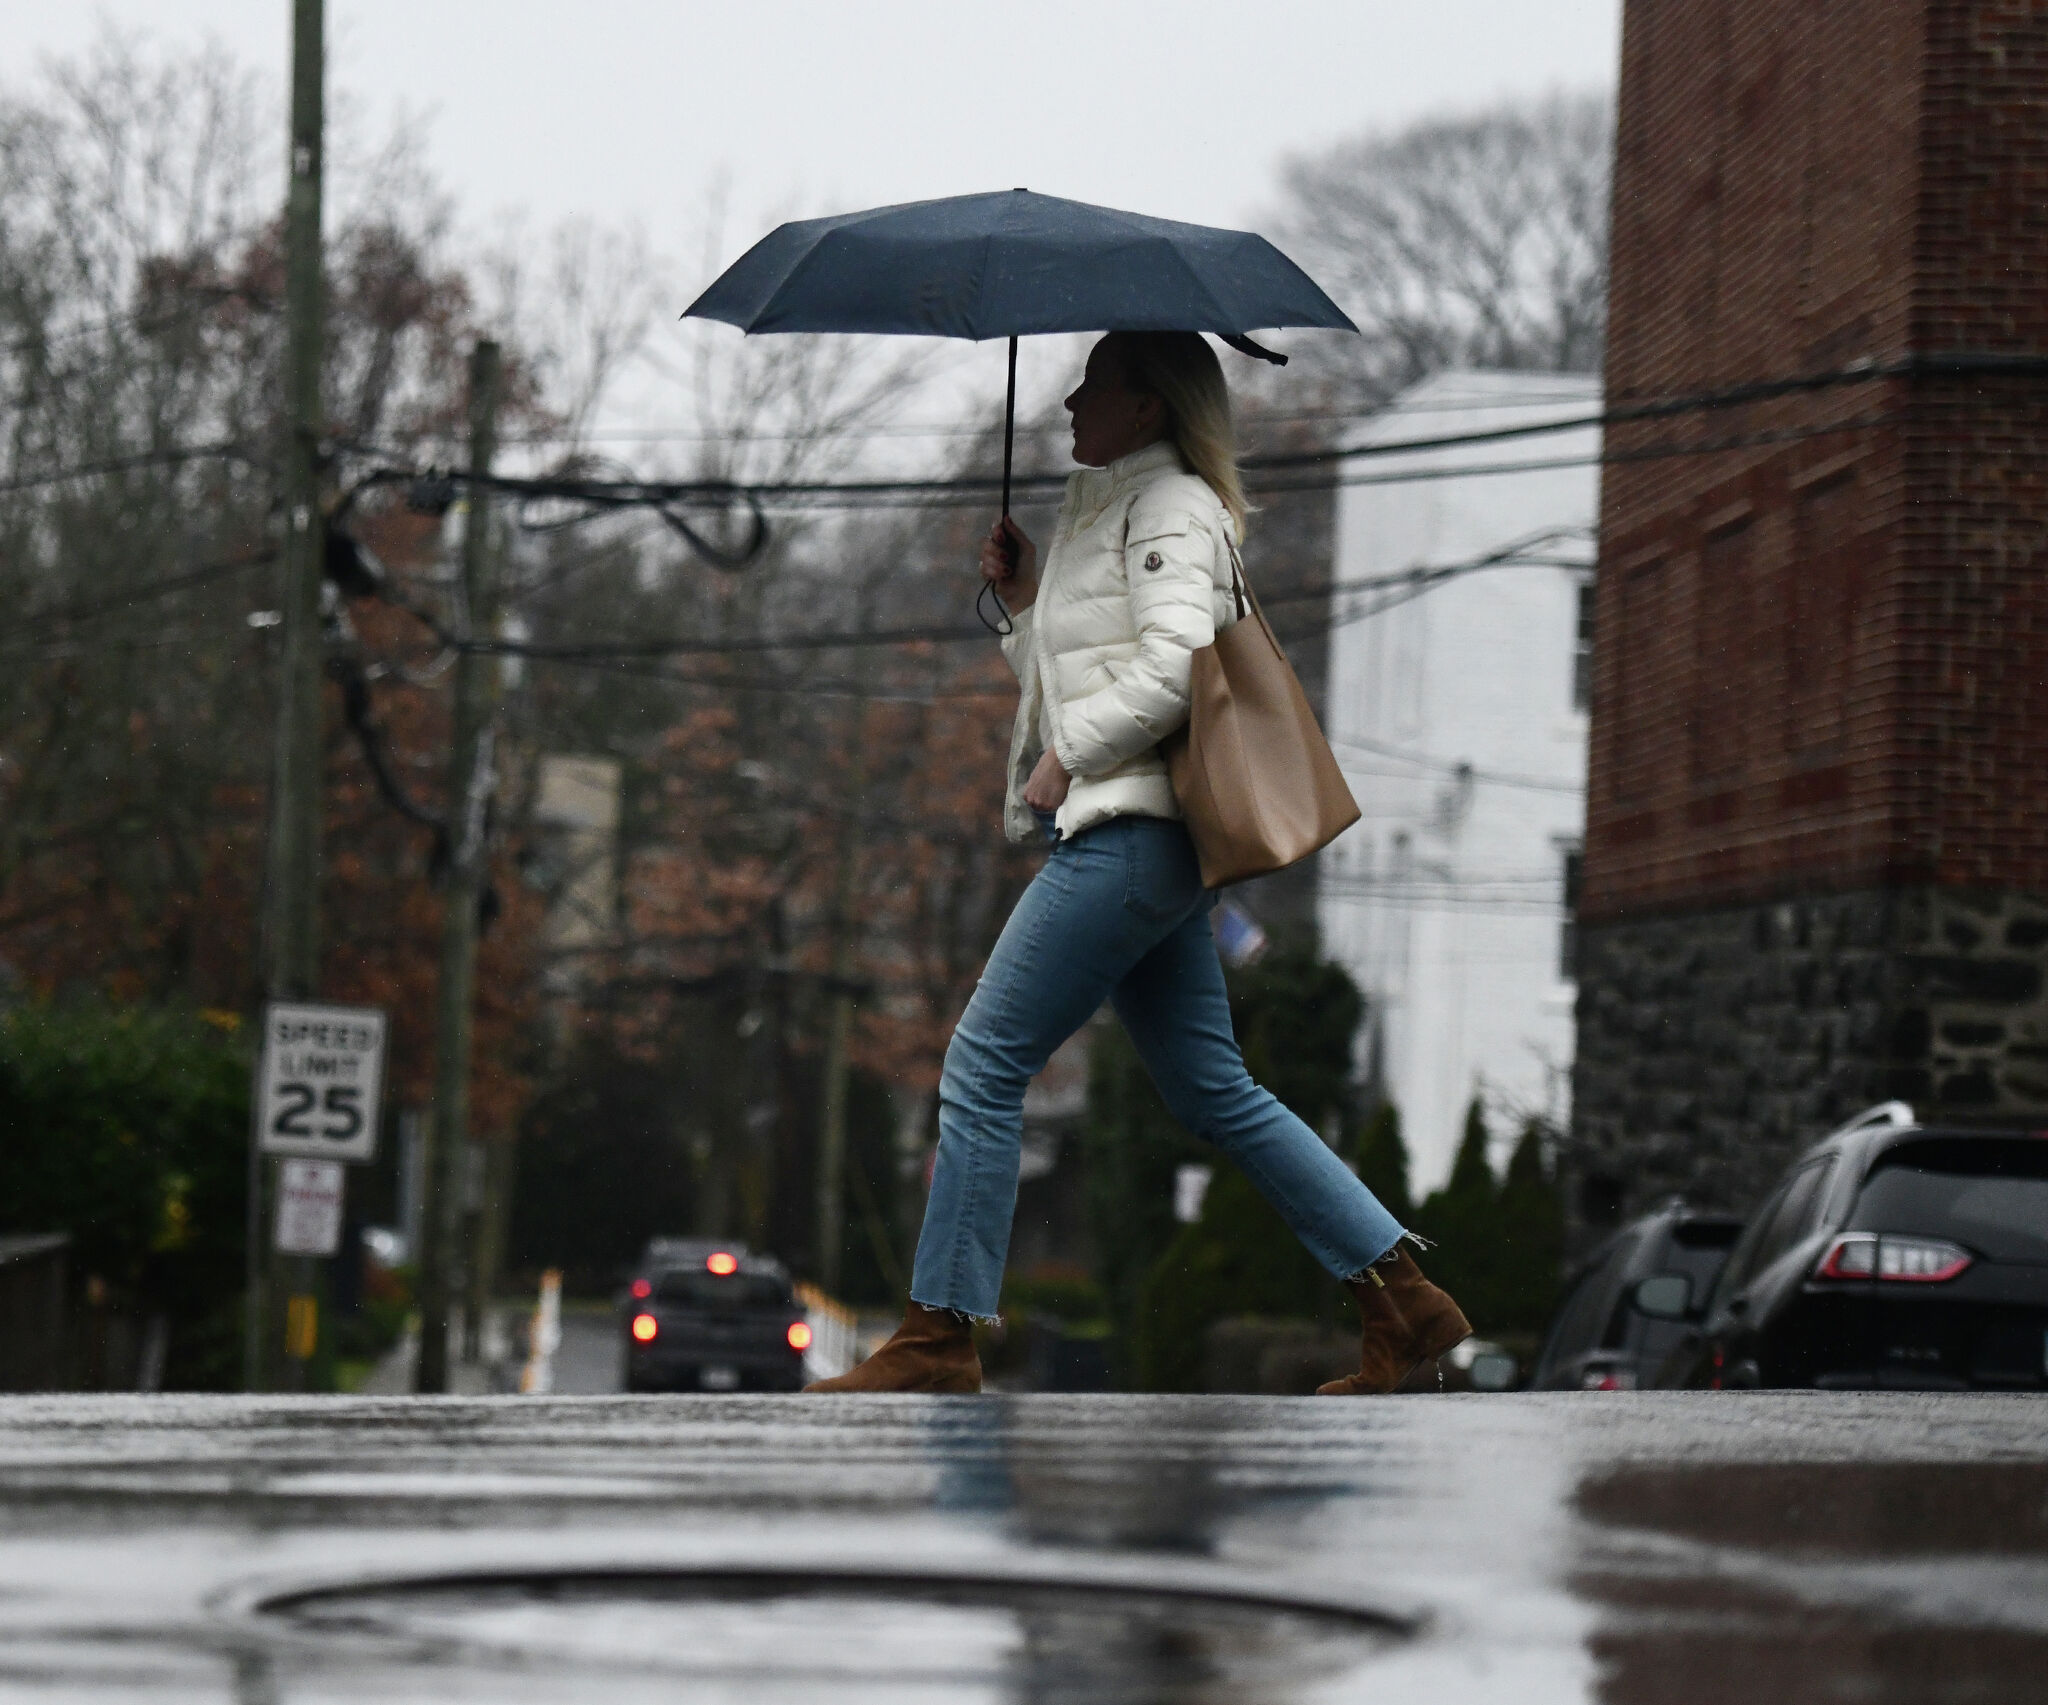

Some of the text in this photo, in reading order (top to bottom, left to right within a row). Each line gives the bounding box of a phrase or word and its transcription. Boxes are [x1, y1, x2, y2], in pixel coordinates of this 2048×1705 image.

[277, 1020, 372, 1050] SPEED
[279, 1052, 360, 1078] LIMIT
[273, 1083, 364, 1142] 25
